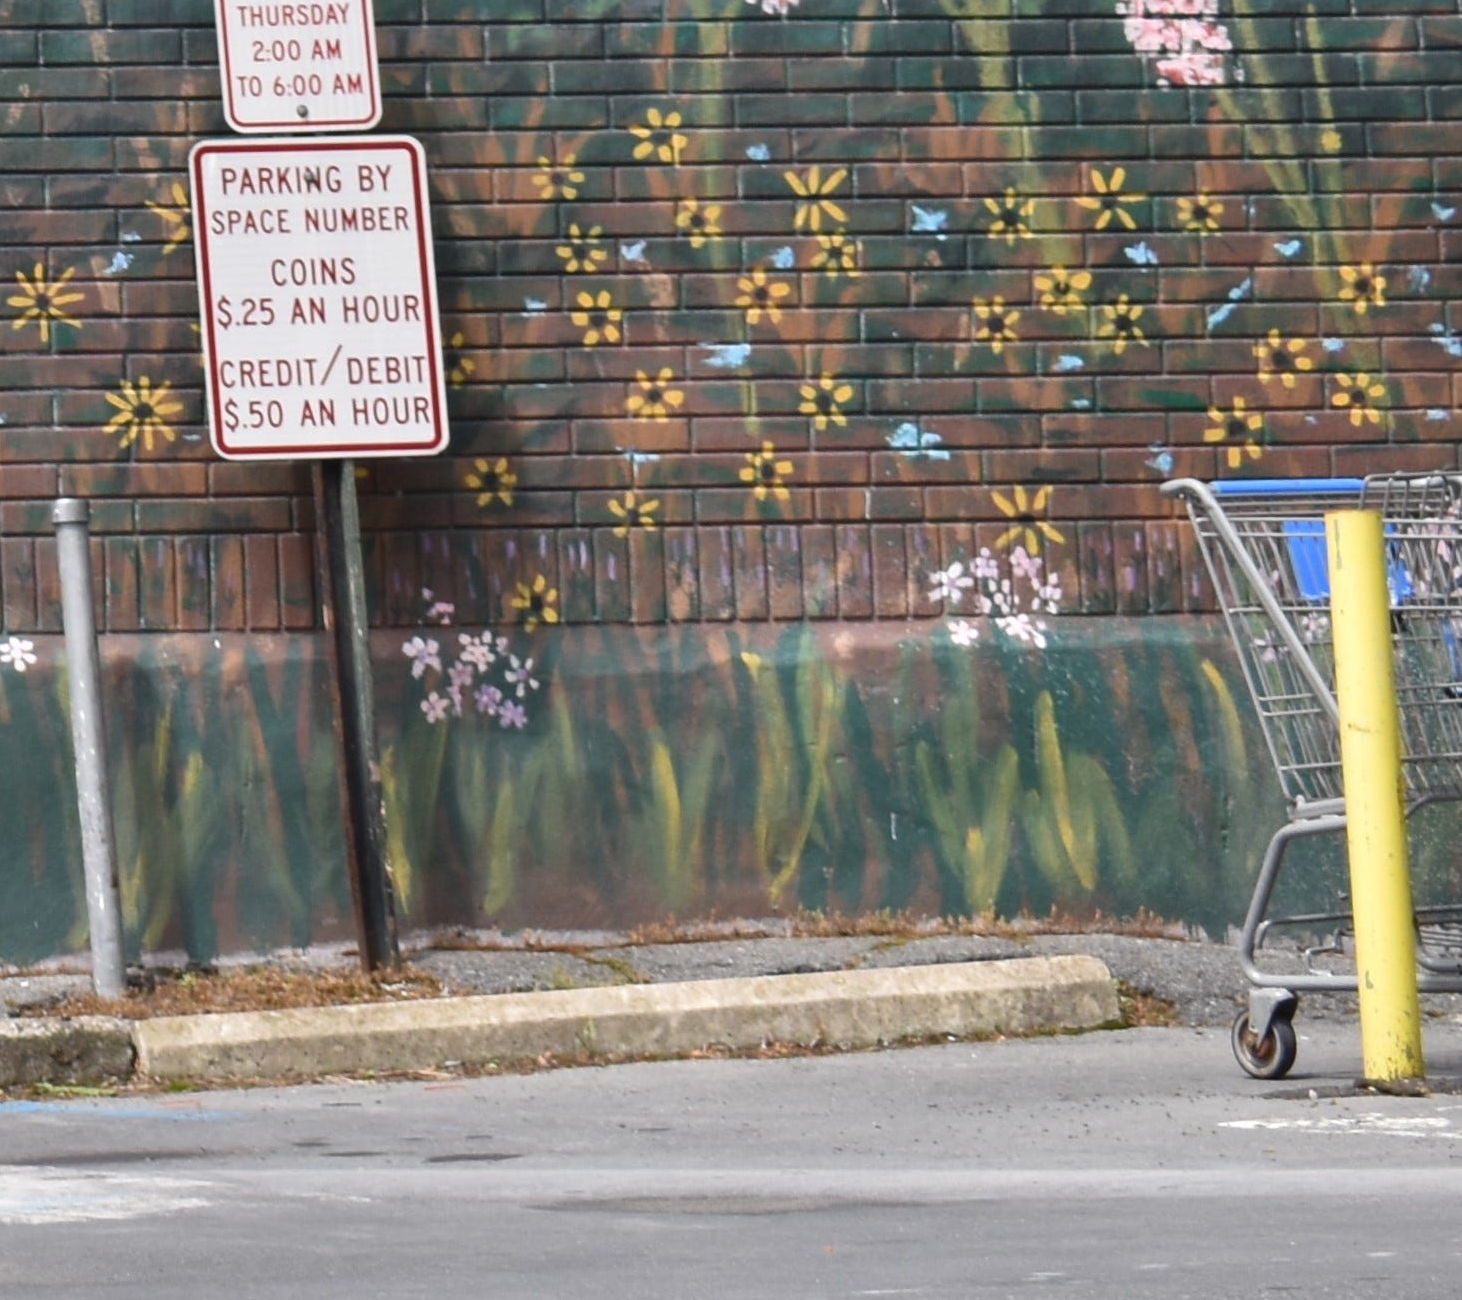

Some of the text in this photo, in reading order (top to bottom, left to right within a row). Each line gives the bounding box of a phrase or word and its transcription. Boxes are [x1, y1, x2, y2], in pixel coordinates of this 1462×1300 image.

[237, 4, 349, 26] THURSDAY
[253, 39, 341, 62] 2:00 AM
[237, 74, 362, 97] TO 6:00 AM
[222, 165, 390, 194] PARKING BY
[212, 207, 408, 234] SPACE NUMBER
[272, 258, 355, 286] COINS
[218, 295, 419, 329] $.25 AN HOUR
[225, 397, 429, 432] $.50 AN HOUR
